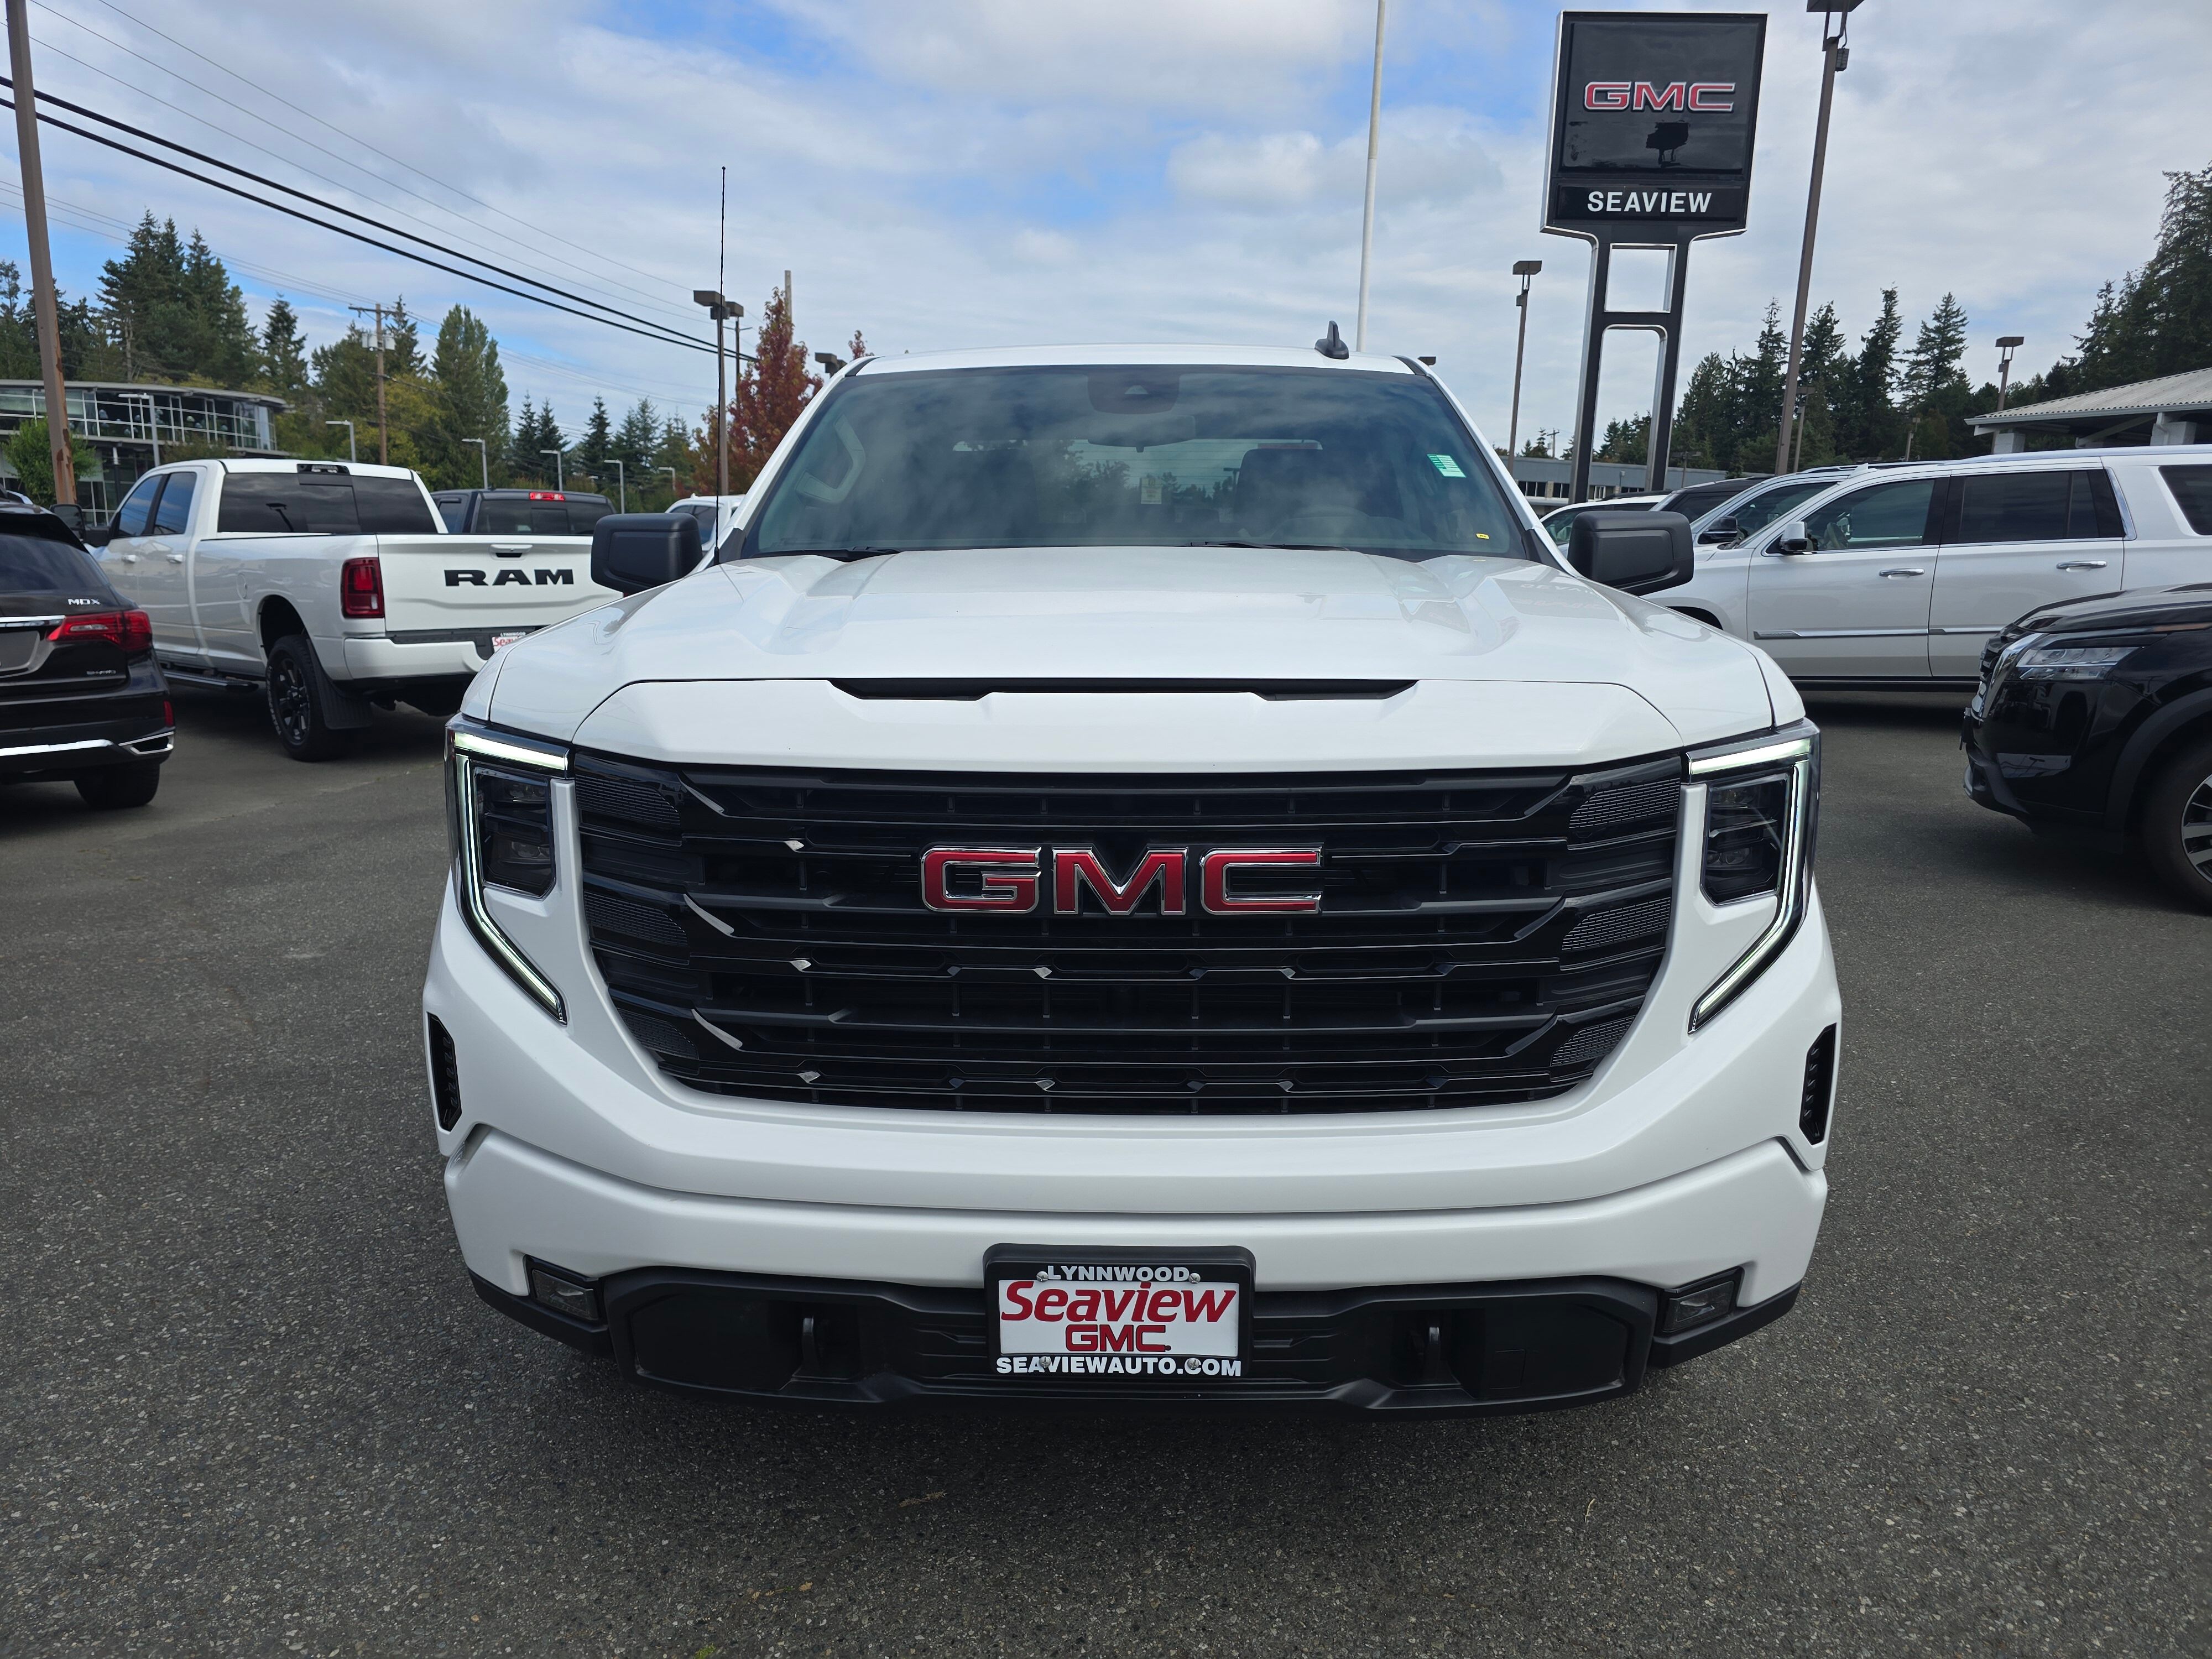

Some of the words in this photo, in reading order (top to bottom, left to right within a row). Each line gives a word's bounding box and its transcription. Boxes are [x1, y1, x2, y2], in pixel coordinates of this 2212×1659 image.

[1584, 81, 1736, 112] GMC
[1587, 191, 1712, 213] SEAVIEW
[444, 569, 574, 586] RAM
[920, 844, 1325, 916] GMC
[1047, 1265, 1190, 1282] LYNNWOOD
[1001, 1281, 1237, 1323] Seaview
[1065, 1324, 1167, 1353] GMC
[996, 1356, 1241, 1376] SEAVIEWAUTO.COM
